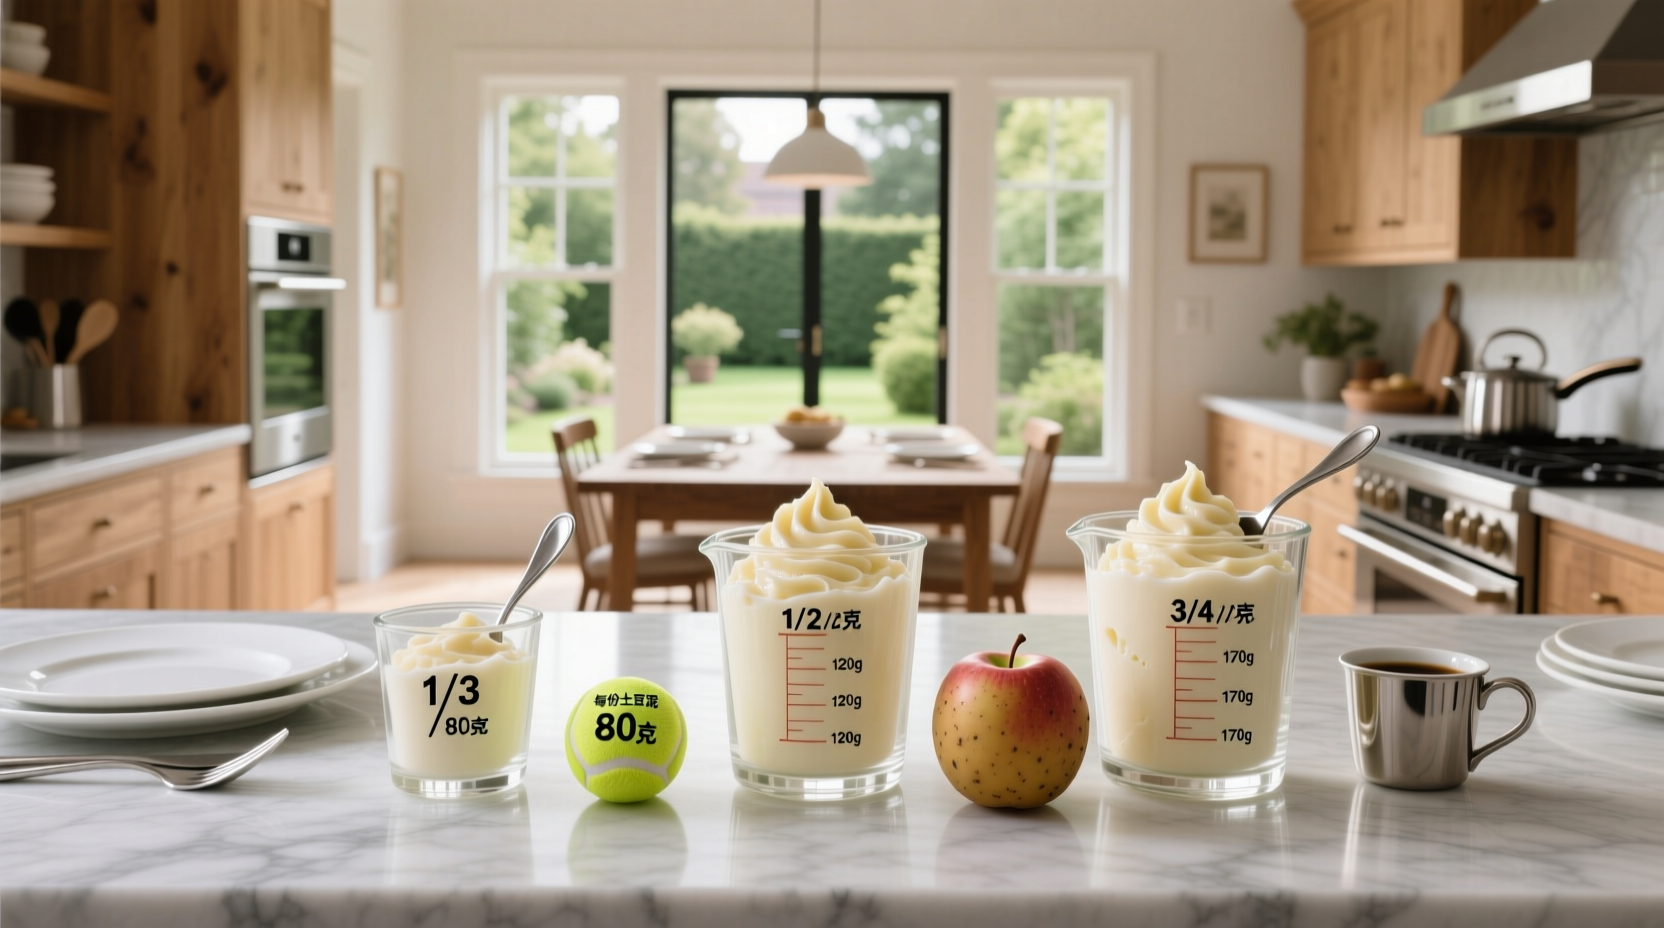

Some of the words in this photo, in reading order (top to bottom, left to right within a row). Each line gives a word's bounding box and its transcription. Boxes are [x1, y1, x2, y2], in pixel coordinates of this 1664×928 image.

[832, 657, 863, 673] 120g
[1223, 650, 1254, 666] 170g
[423, 673, 480, 737] 1/3
[831, 694, 862, 710] 120g
[1222, 690, 1253, 706] 170g
[445, 716, 489, 736] 80克
[595, 712, 657, 745] 80克
[831, 731, 862, 747] 120g
[1221, 728, 1252, 745] 170g
